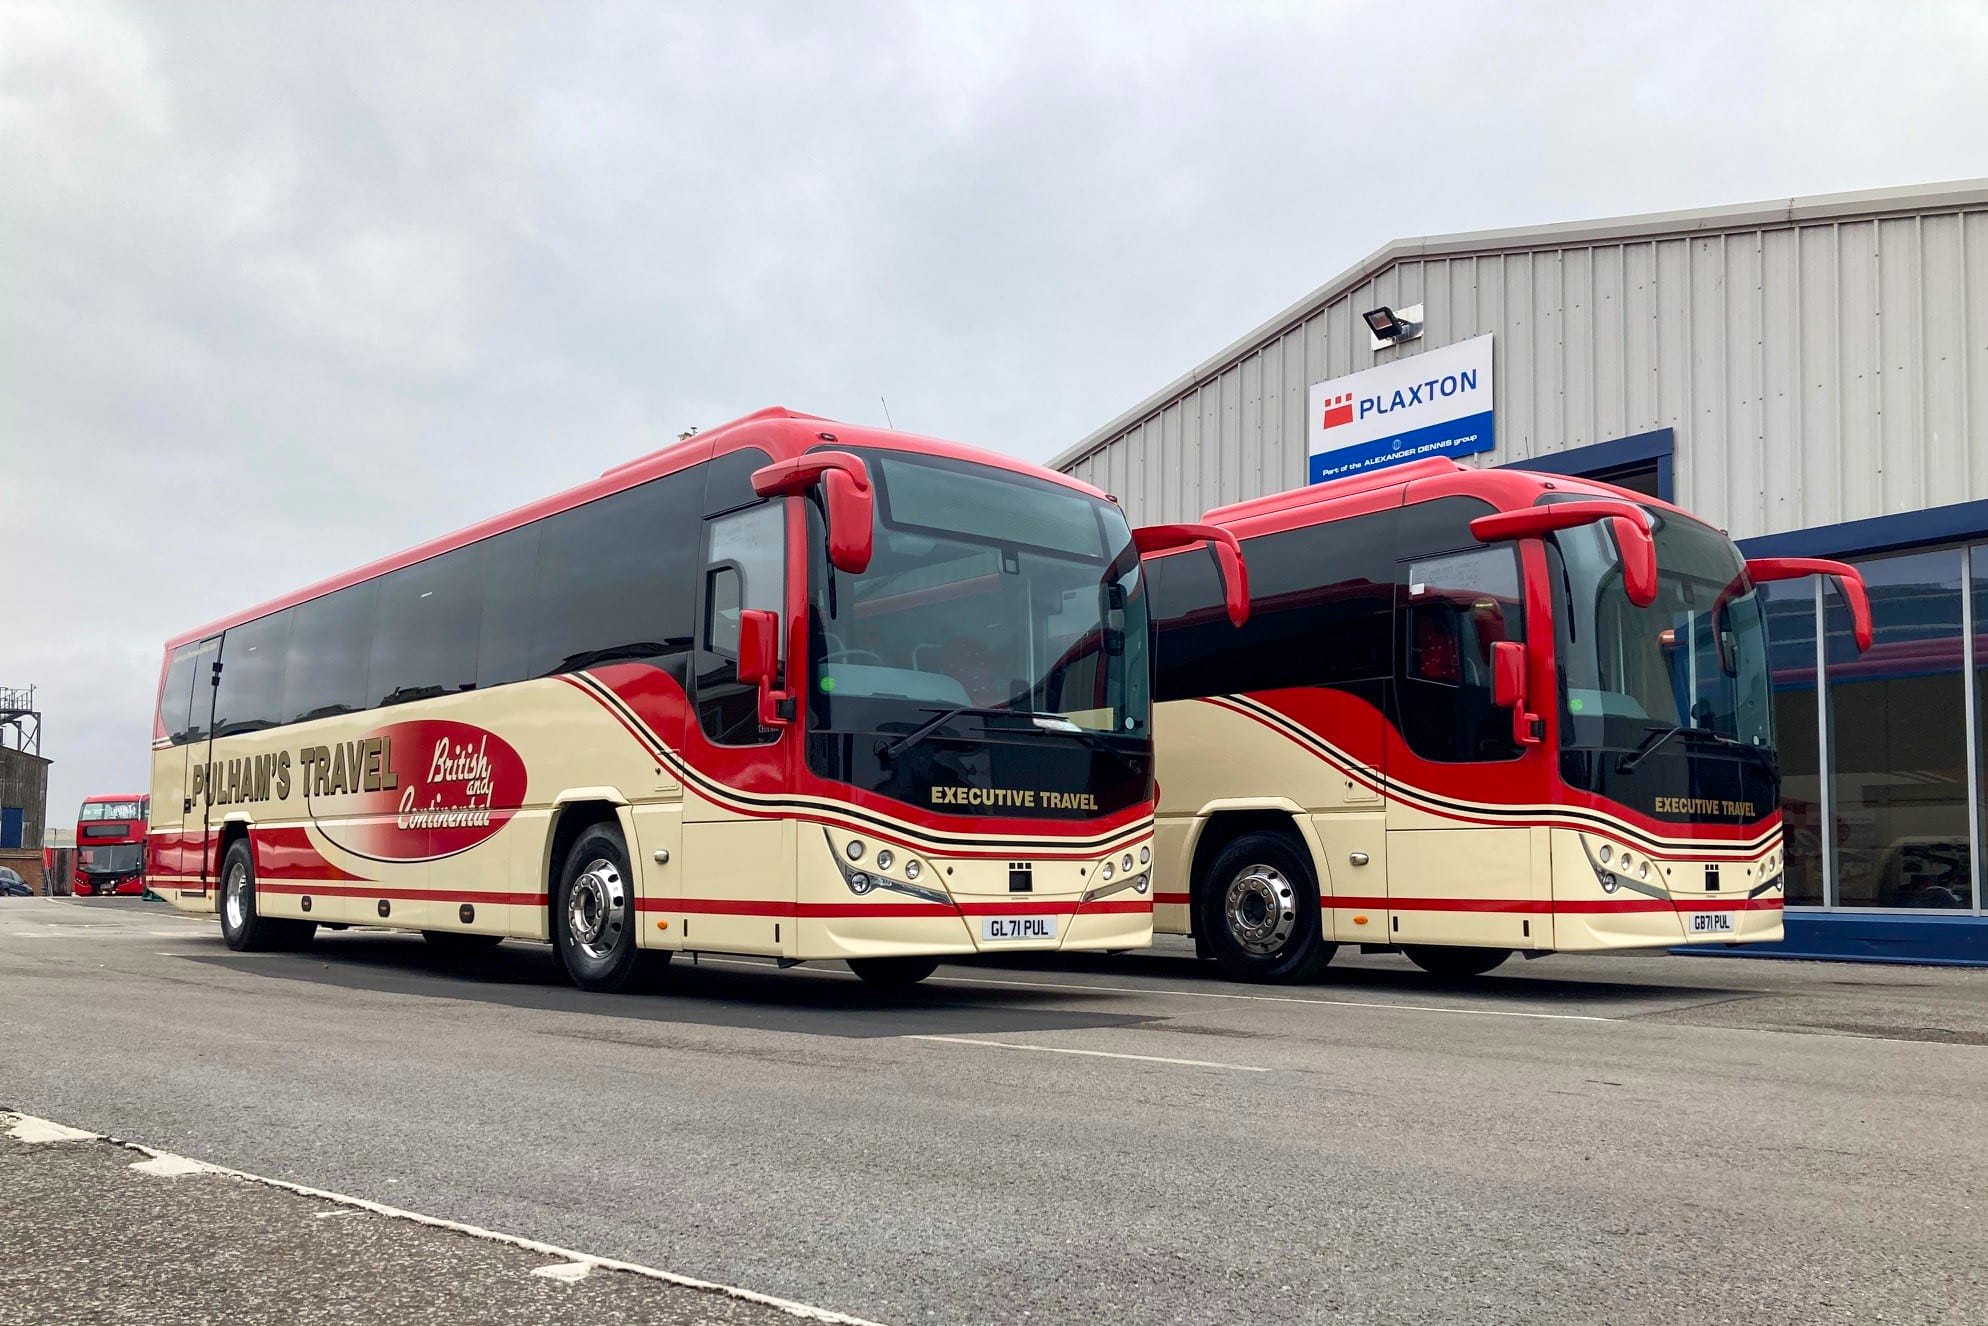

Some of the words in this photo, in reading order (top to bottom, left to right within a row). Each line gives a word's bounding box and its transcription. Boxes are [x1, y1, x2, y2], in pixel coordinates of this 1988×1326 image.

[1359, 368, 1477, 420] PLAXTON
[1322, 467, 1339, 477] Part
[1340, 464, 1348, 472] of
[1349, 460, 1362, 470] the
[1364, 448, 1416, 466] ALEXANDER
[1417, 439, 1453, 454] DENNIS
[1453, 433, 1478, 447] group
[192, 749, 291, 808] PULHAM'S
[300, 735, 399, 798] TRAVEL
[427, 734, 491, 784] British
[466, 768, 494, 796] and
[931, 786, 1035, 808] EXECUTIVE
[1040, 791, 1098, 810] TRAVEL
[397, 783, 494, 830] Continental
[1655, 797, 1720, 815] EXECUTIVE
[1722, 801, 1756, 817] TRAVEL
[991, 919, 1021, 937] GL71
[1024, 919, 1049, 936] PUL
[1694, 915, 1713, 930] GB71
[1714, 914, 1730, 929] PUL
